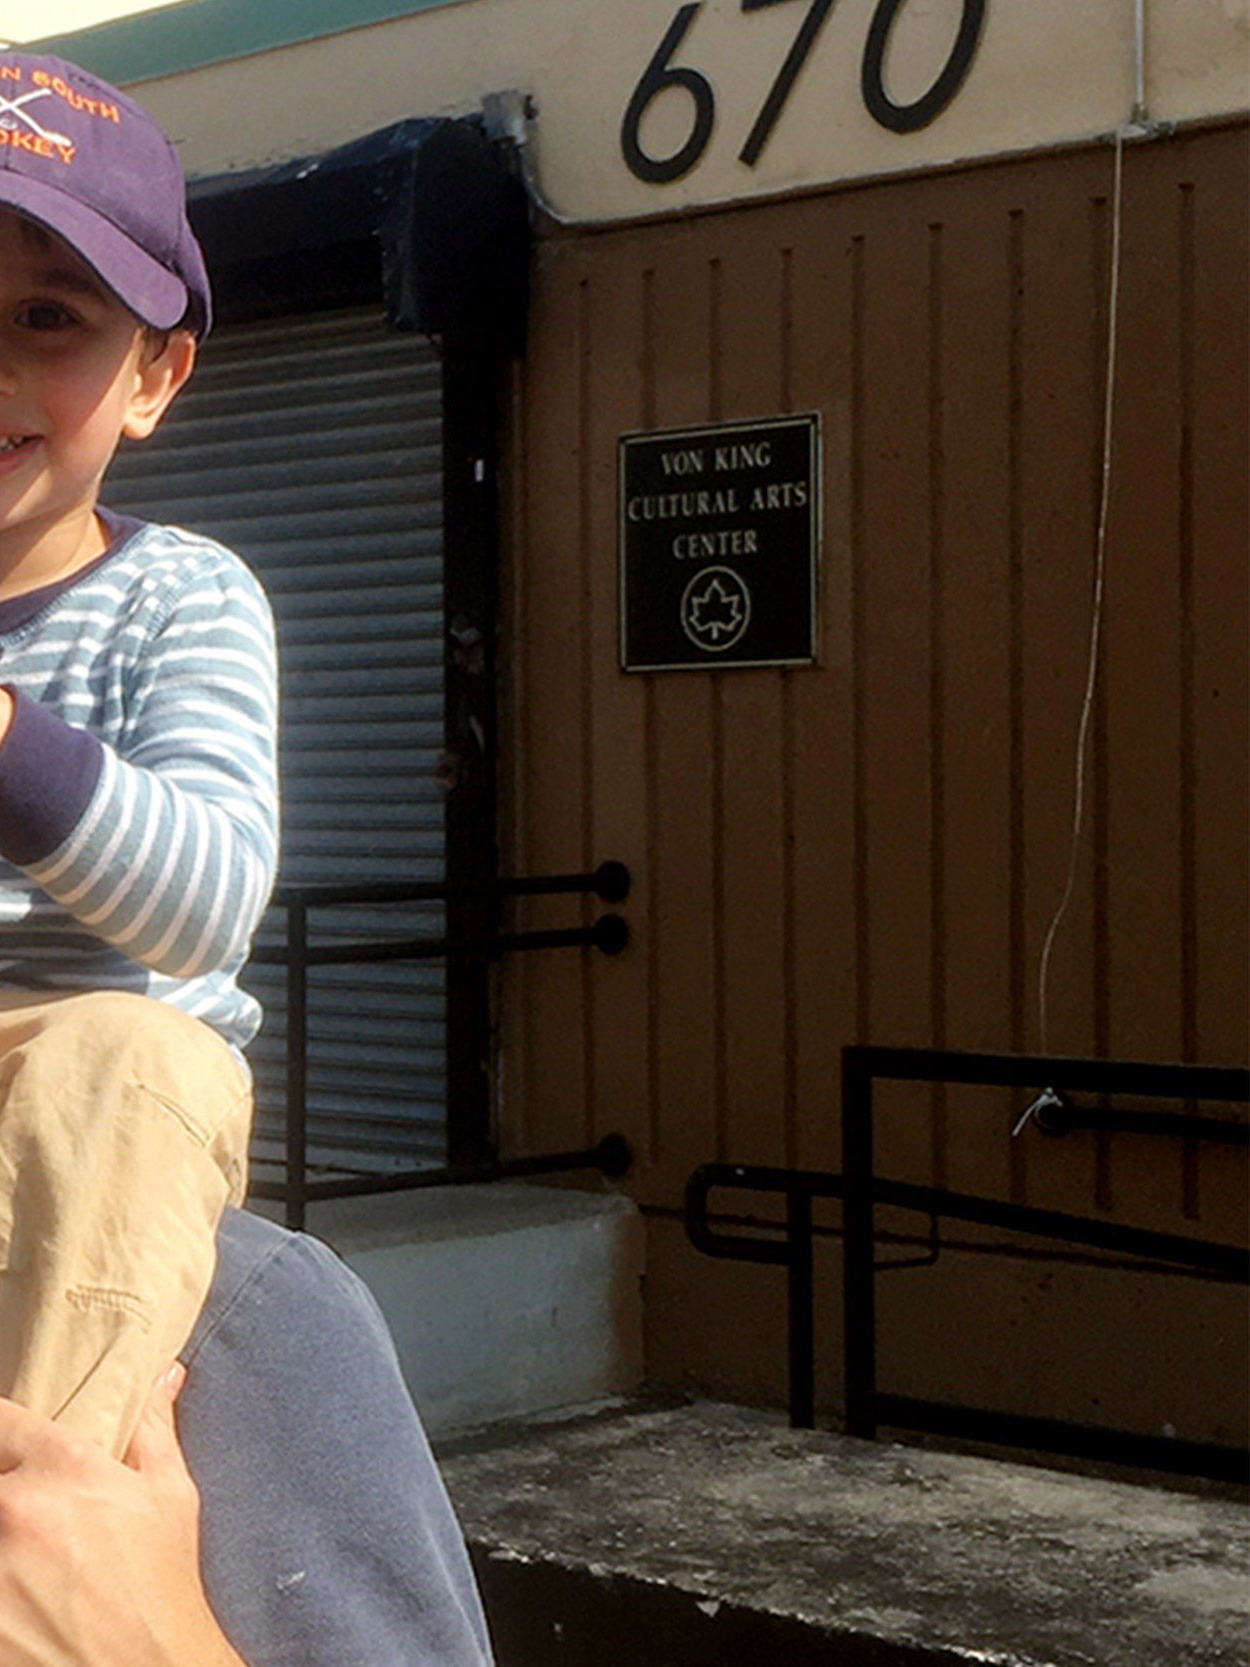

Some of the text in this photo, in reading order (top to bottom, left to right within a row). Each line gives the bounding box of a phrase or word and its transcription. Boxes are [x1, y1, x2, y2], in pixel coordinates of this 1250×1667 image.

[30, 69, 121, 124] SOUTH
[620, 0, 986, 184] 670
[661, 441, 772, 476] VON KING
[627, 480, 808, 521] CULTURAL ARTS
[671, 528, 759, 560] CENTER
